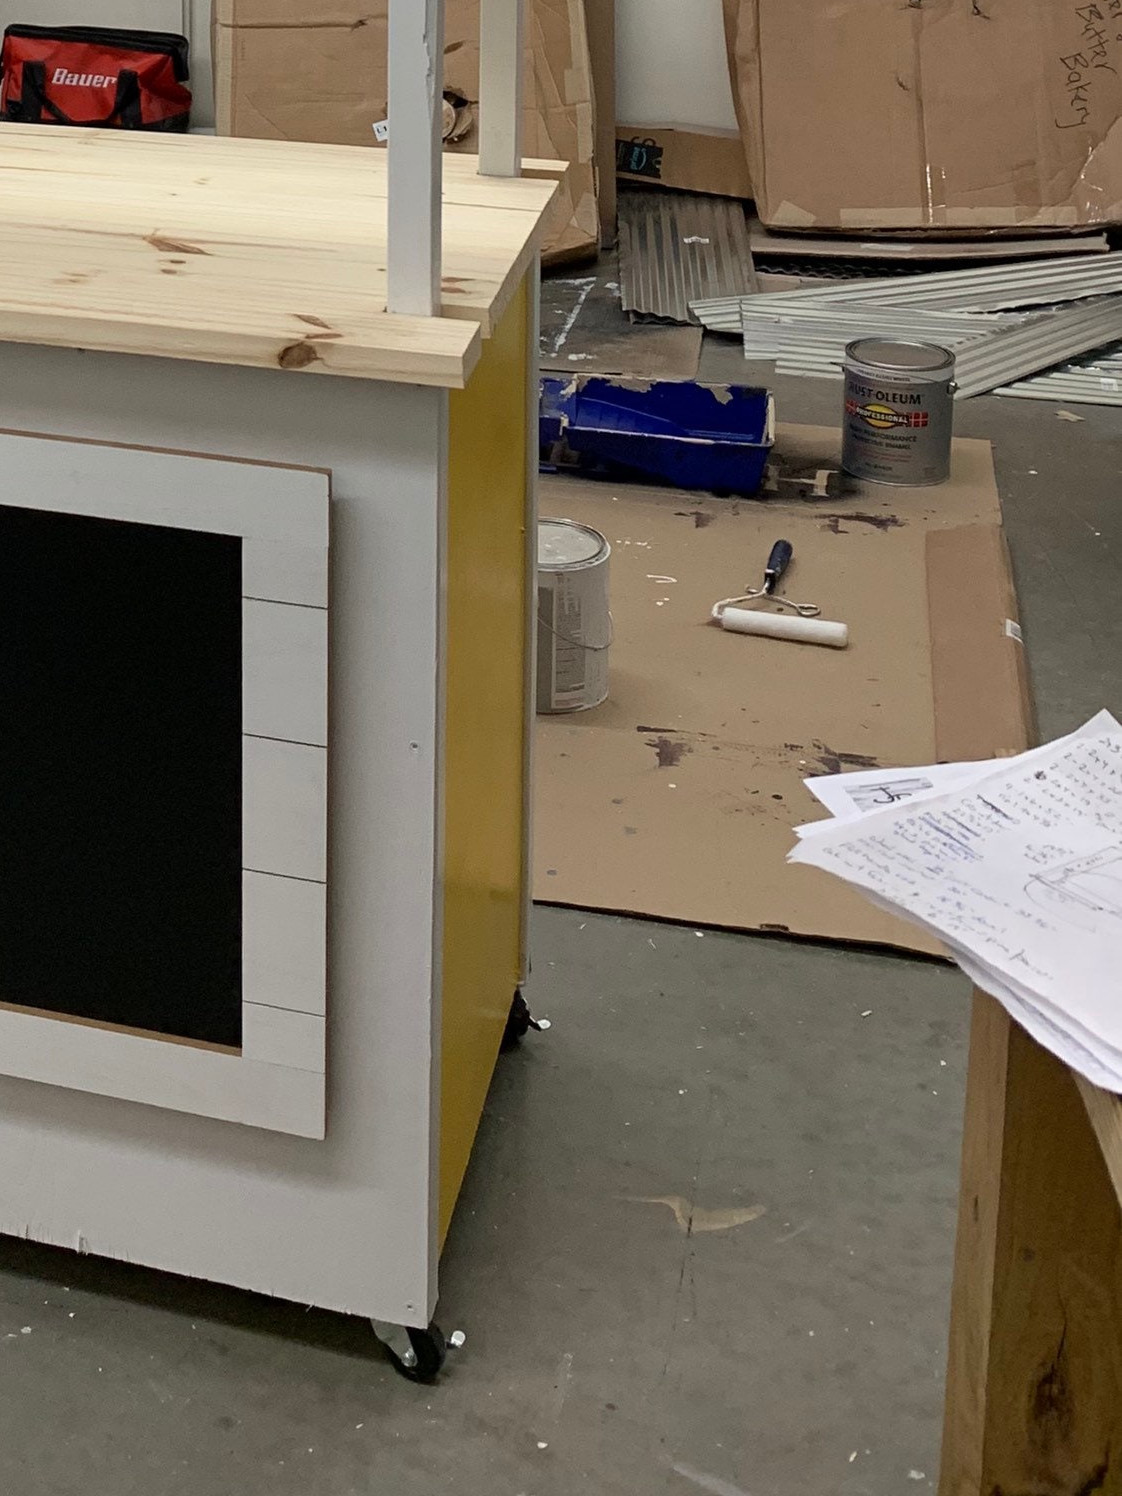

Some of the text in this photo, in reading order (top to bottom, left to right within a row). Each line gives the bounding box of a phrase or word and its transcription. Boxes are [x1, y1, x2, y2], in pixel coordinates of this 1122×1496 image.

[1075, 4, 1118, 75] Butter
[51, 67, 118, 88] Bauer
[1055, 52, 1093, 129] Bakery
[856, 406, 909, 423] PROFESSIONAL
